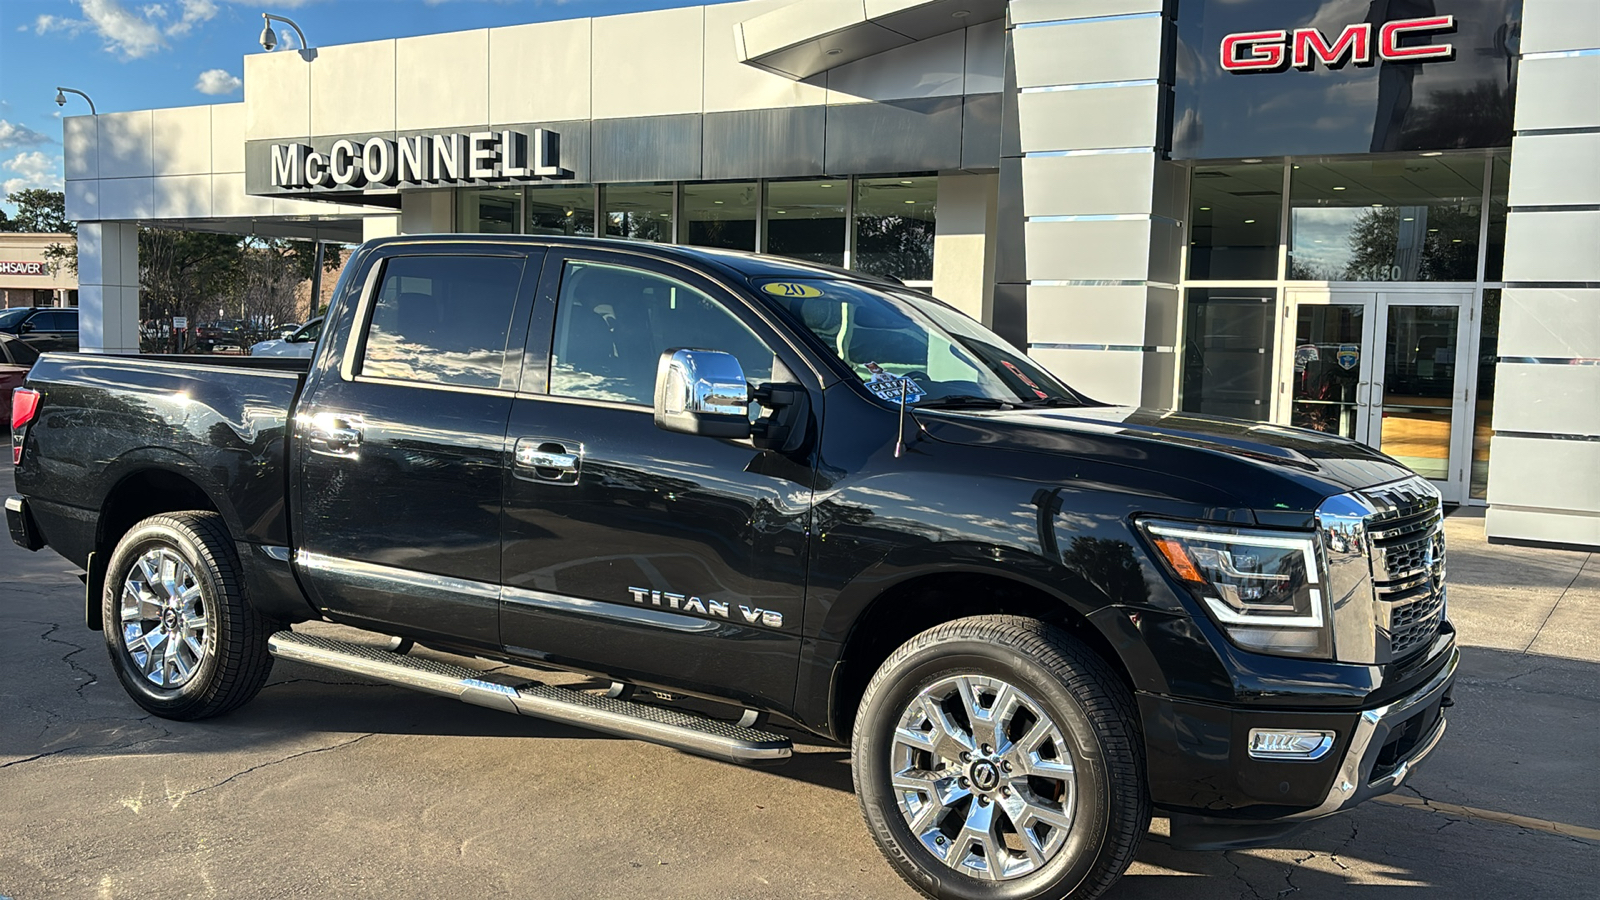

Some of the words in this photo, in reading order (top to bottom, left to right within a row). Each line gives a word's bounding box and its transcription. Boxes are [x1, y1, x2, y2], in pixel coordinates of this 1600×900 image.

[1219, 14, 1454, 71] GMC
[270, 128, 561, 188] McCONNELL
[777, 283, 806, 296] 20
[1357, 265, 1402, 281] 3150
[628, 586, 729, 618] TITAN
[739, 604, 783, 628] V8
